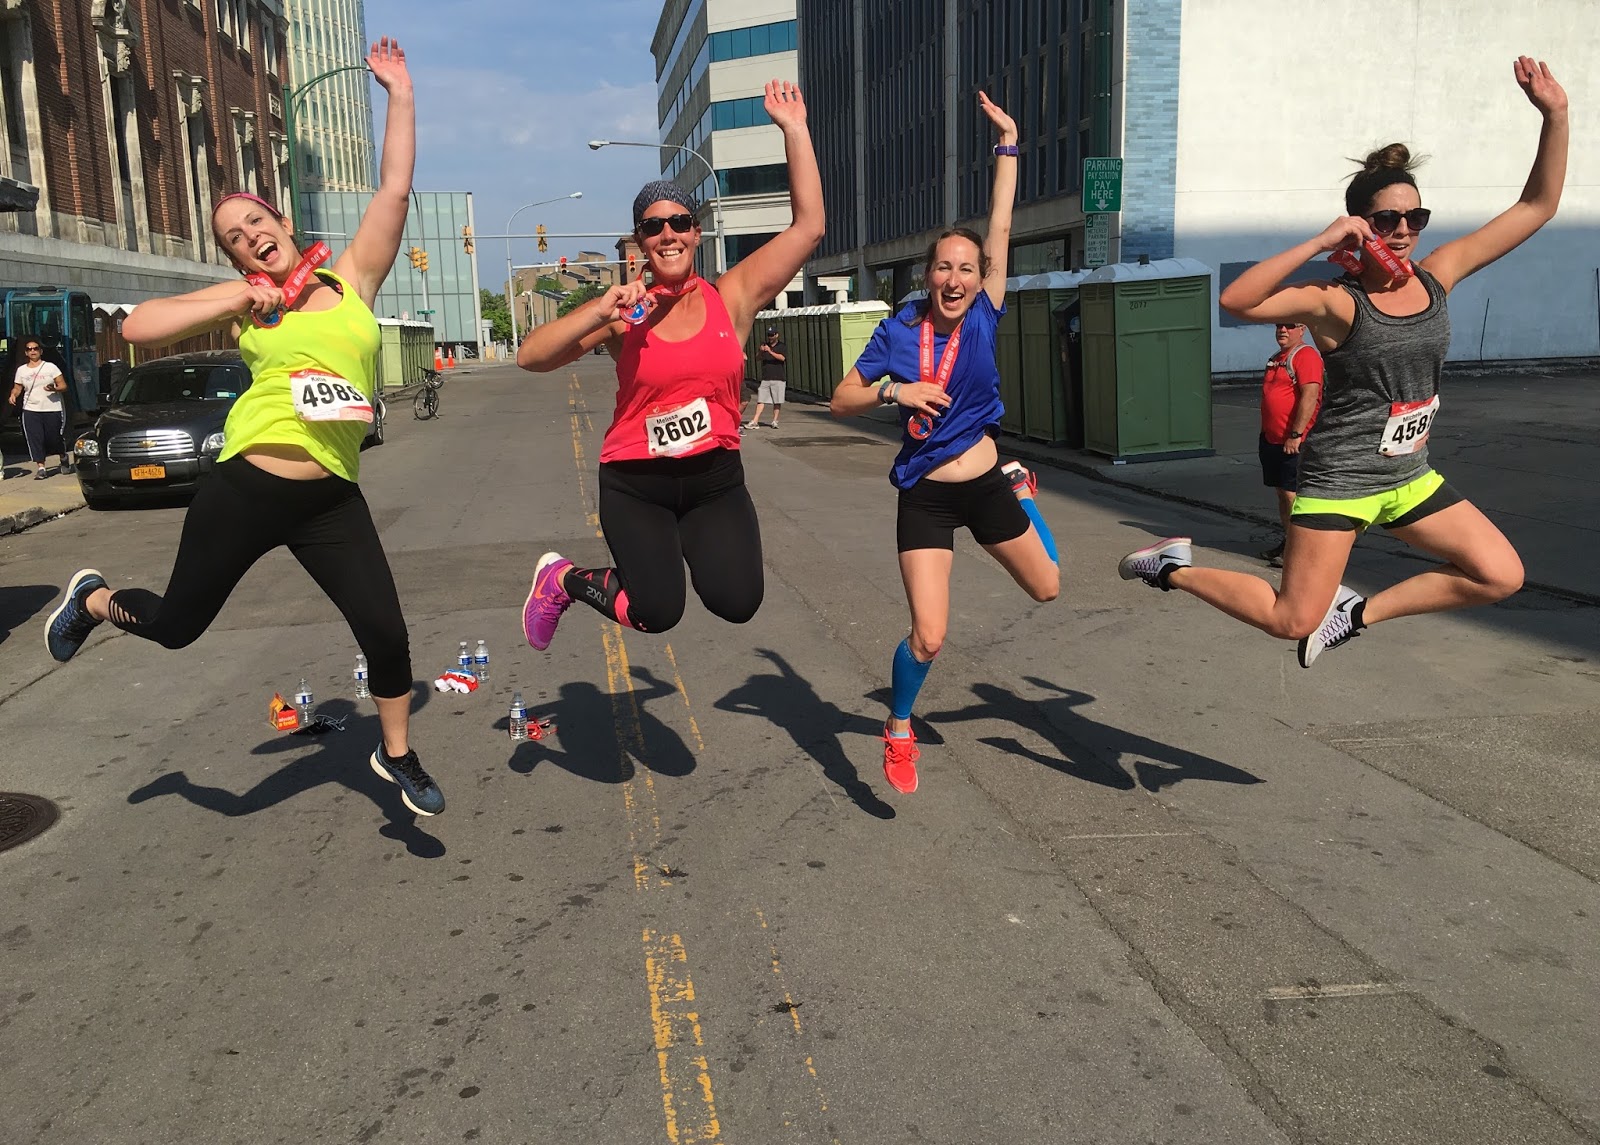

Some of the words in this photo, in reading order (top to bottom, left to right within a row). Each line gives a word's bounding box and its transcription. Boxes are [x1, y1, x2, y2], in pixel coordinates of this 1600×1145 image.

[1086, 160, 1121, 171] PARKING
[1087, 171, 1098, 180] PAY
[1098, 171, 1119, 180] STATION
[1094, 180, 1112, 190] PAY
[1091, 189, 1114, 200] HERE
[1086, 215, 1093, 228] 2
[1377, 248, 1391, 261] HALF
[292, 261, 314, 287] MEMORIAL
[310, 252, 321, 265] DAY
[302, 382, 364, 408] 4989
[656, 414, 679, 424] Melissa
[653, 410, 708, 446] 2602
[586, 585, 607, 607] 2XU
